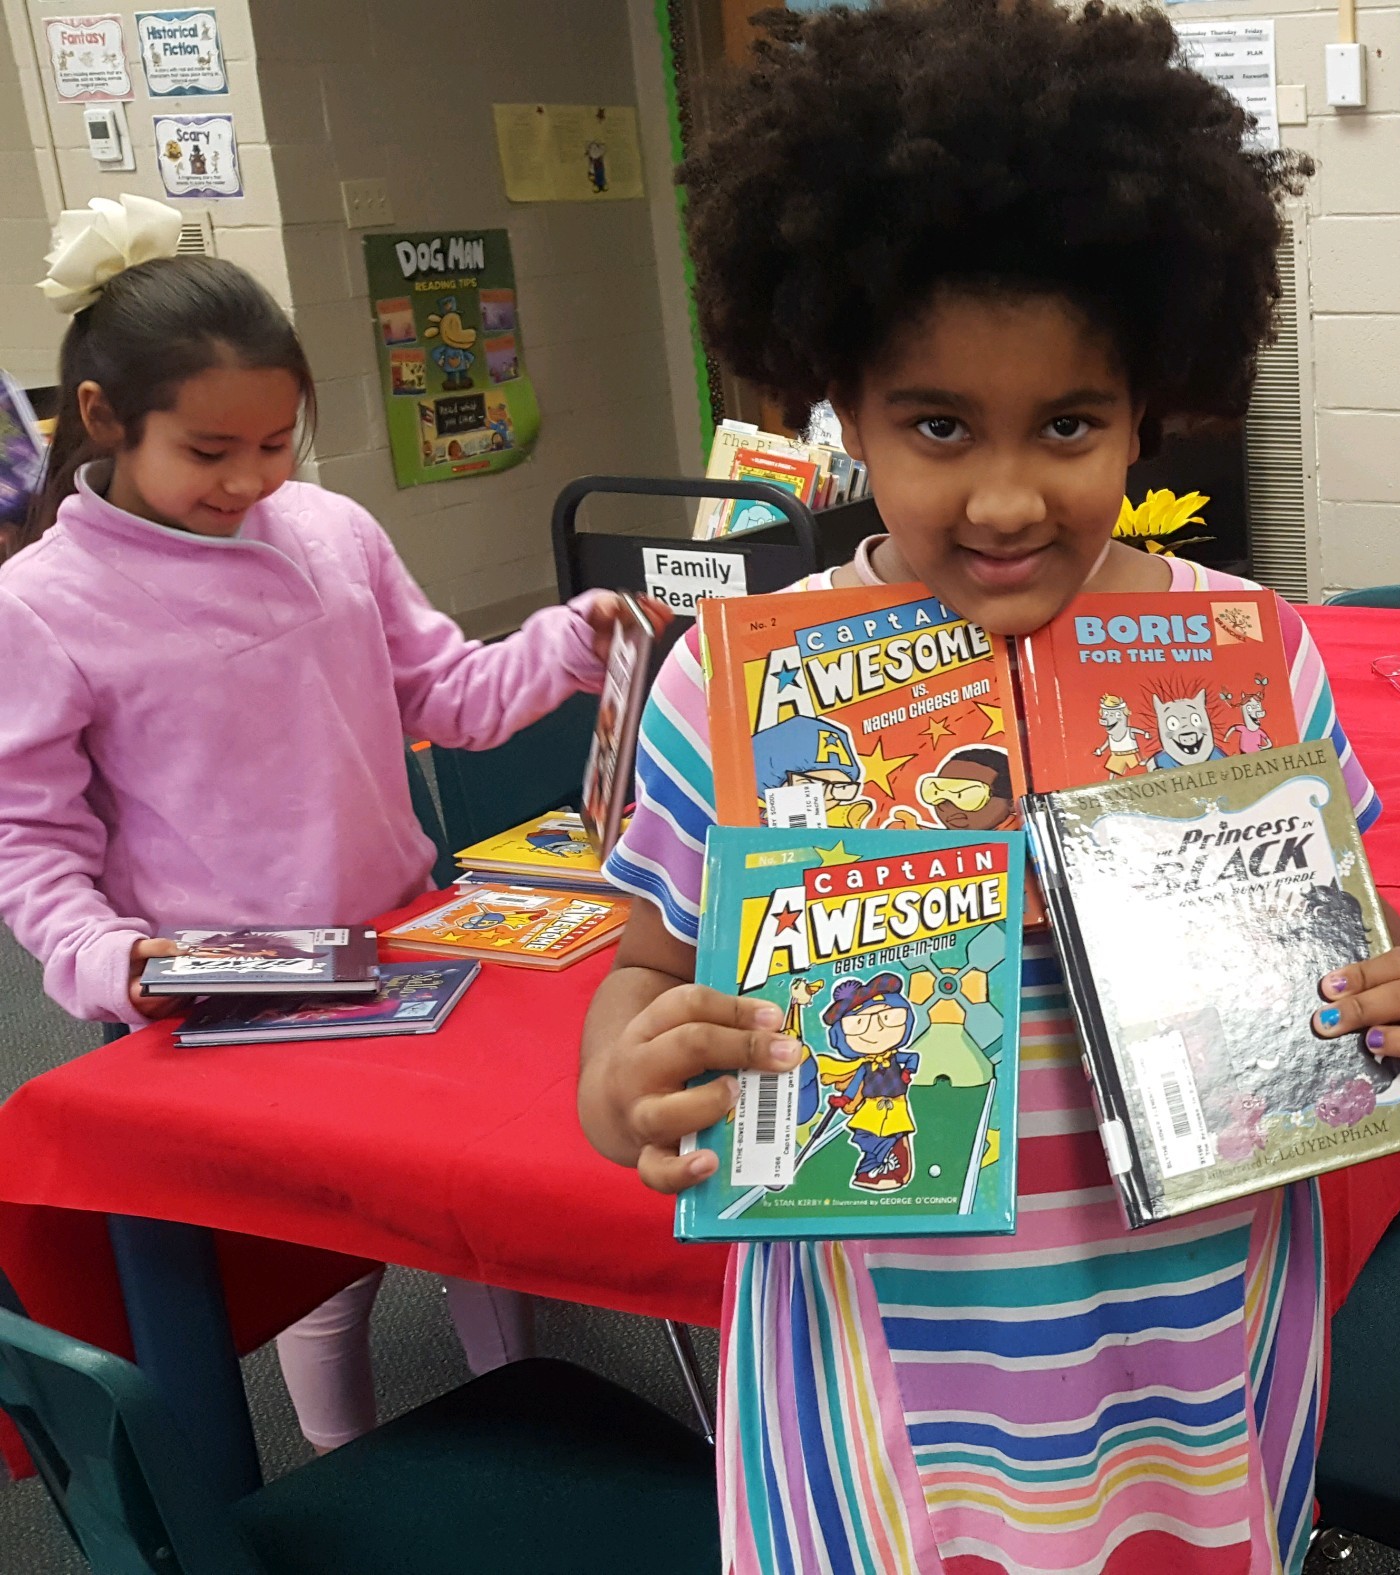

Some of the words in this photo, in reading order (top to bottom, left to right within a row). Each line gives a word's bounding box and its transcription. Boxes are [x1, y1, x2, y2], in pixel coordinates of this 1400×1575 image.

[60, 30, 106, 46] Fantasy
[146, 24, 198, 40] Historical
[162, 42, 200, 56] Fiction
[176, 128, 210, 145] Scary
[395, 238, 445, 277] DOG
[448, 237, 485, 270] MAN
[415, 279, 456, 291] READING
[459, 277, 478, 289] TIPS
[722, 432, 749, 447] The
[656, 554, 731, 584] Family
[771, 617, 777, 627] 2
[1074, 614, 1213, 646] BORIS
[1079, 649, 1121, 664] FOR
[1127, 648, 1166, 663] THE
[1171, 648, 1213, 663] WIN
[757, 621, 993, 732] AWESOME
[1171, 770, 1218, 793] HALE
[1231, 757, 1280, 782] DEAN
[1282, 749, 1328, 771] HALE
[1178, 815, 1301, 855] Princess
[781, 852, 795, 864] 12
[525, 899, 613, 950] AWESOME
[739, 877, 1004, 995] AWESOME
[784, 1091, 793, 1120] Awesome
[782, 1124, 791, 1154] Captain
[1340, 1119, 1390, 1144] PHAM
[880, 1197, 912, 1205] GEORGE
[915, 1196, 957, 1205] O'CONNOR
